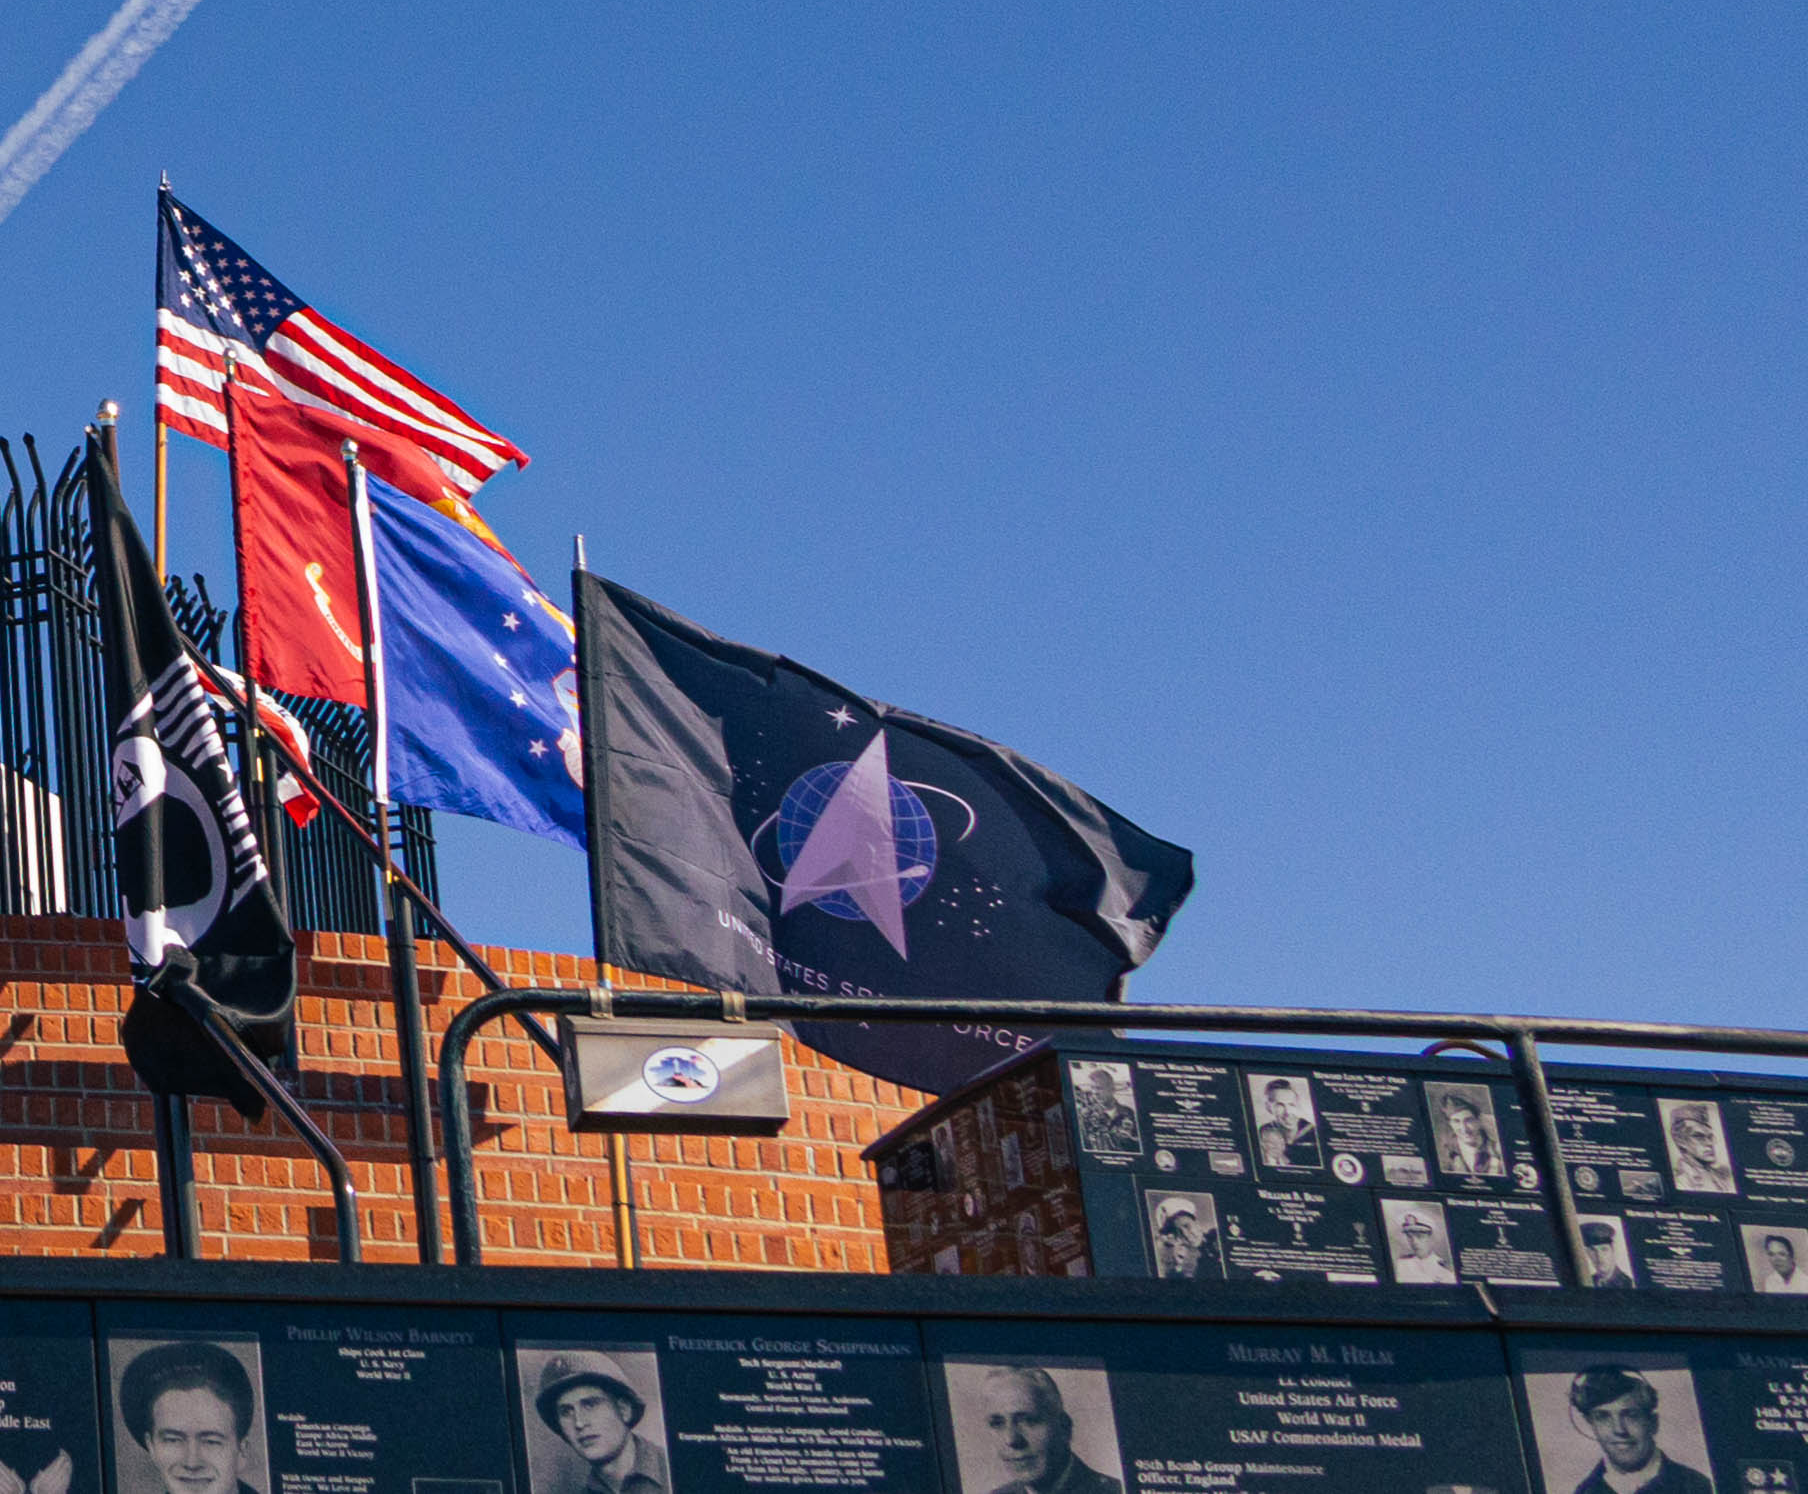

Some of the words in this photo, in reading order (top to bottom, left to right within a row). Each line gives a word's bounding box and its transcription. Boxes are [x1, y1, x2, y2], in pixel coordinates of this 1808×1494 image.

[766, 946, 830, 991] STATES
[346, 1327, 403, 1343] WILSON
[668, 1335, 746, 1351] FREDERICK
[752, 1337, 812, 1353] GEORGE
[1228, 1343, 1303, 1363] MURRAY
[382, 1361, 405, 1370] Navy
[356, 1370, 382, 1379] World
[384, 1371, 402, 1380] War
[792, 1371, 816, 1381] Army
[765, 1381, 793, 1390] World
[794, 1382, 813, 1391] War
[1238, 1391, 1285, 1406] United
[1287, 1392, 1331, 1407] States
[1335, 1393, 1357, 1407] Air
[1359, 1394, 1399, 1409] Force
[24, 1416, 51, 1429] East
[1277, 1411, 1320, 1426] World
[1322, 1412, 1351, 1426] War
[1354, 1413, 1366, 1426] II
[1229, 1429, 1269, 1444] USAF
[1272, 1430, 1376, 1446] Commendation
[1379, 1433, 1421, 1448] Medal
[1167, 1460, 1202, 1472] Bomb
[1205, 1461, 1243, 1475] Group
[1245, 1462, 1324, 1475] Maintenance
[1185, 1473, 1236, 1488] England
